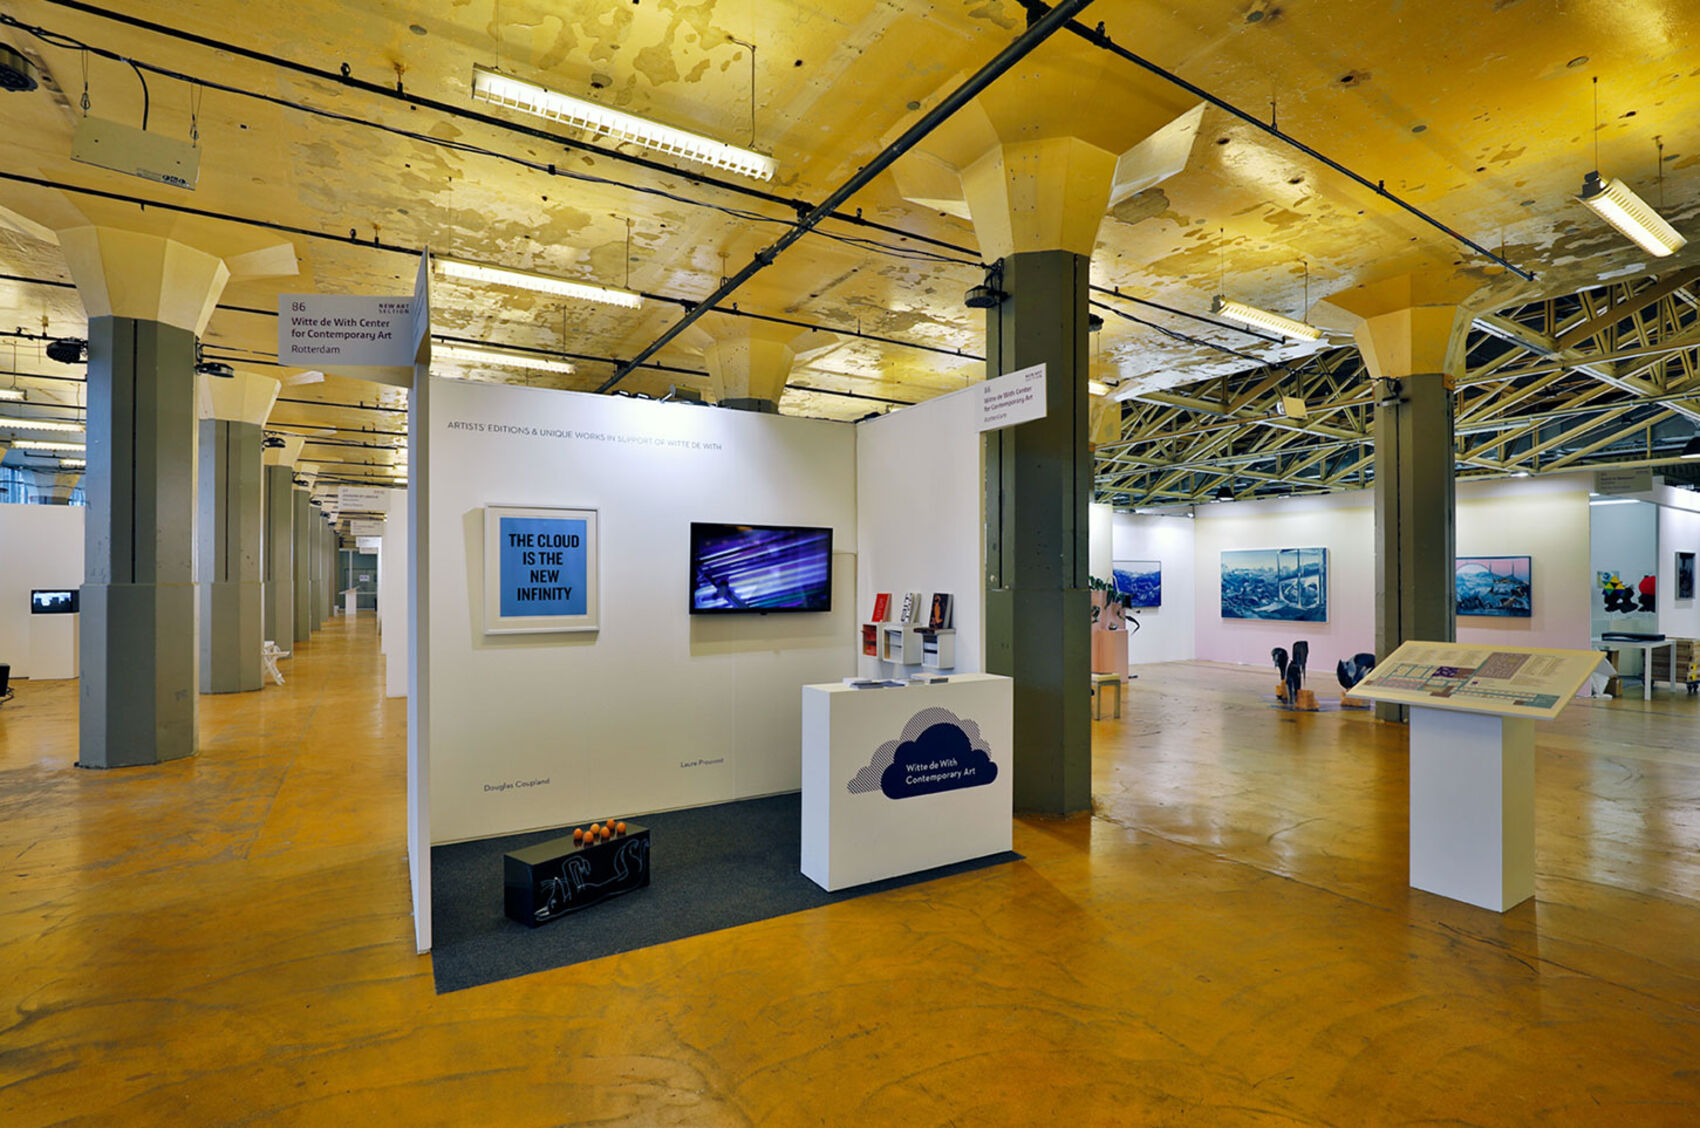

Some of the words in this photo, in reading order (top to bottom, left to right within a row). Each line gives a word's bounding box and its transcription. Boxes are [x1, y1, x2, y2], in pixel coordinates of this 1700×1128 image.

[291, 302, 306, 312] 86
[291, 318, 318, 327] Witte
[320, 318, 332, 327] de
[333, 318, 357, 327] With
[359, 319, 390, 328] Center
[291, 330, 306, 339] for
[307, 330, 376, 341] Contemporary
[377, 331, 392, 340] Art
[291, 345, 341, 354] Rotterdam
[488, 424, 530, 435] EDITIONS
[540, 429, 573, 438] UNIQUE
[575, 431, 606, 441] WORKS
[607, 434, 616, 442] IN
[617, 435, 652, 445] SUPPORT
[654, 437, 665, 446] OF
[668, 439, 690, 448] WITTE
[691, 441, 701, 449] DE
[703, 442, 723, 451] WITH
[508, 534, 534, 548] THE
[537, 534, 580, 548] CLOUD
[522, 552, 536, 565] IS
[538, 552, 563, 565] THE
[530, 570, 560, 583] NEW
[517, 587, 572, 601] INFINITY
[905, 763, 928, 772] Witte
[929, 761, 939, 769] de
[939, 758, 958, 767] With
[906, 769, 962, 784] Contemporary
[963, 767, 976, 776] Art
[483, 782, 514, 792] Douglas
[515, 778, 550, 788] Coupland
